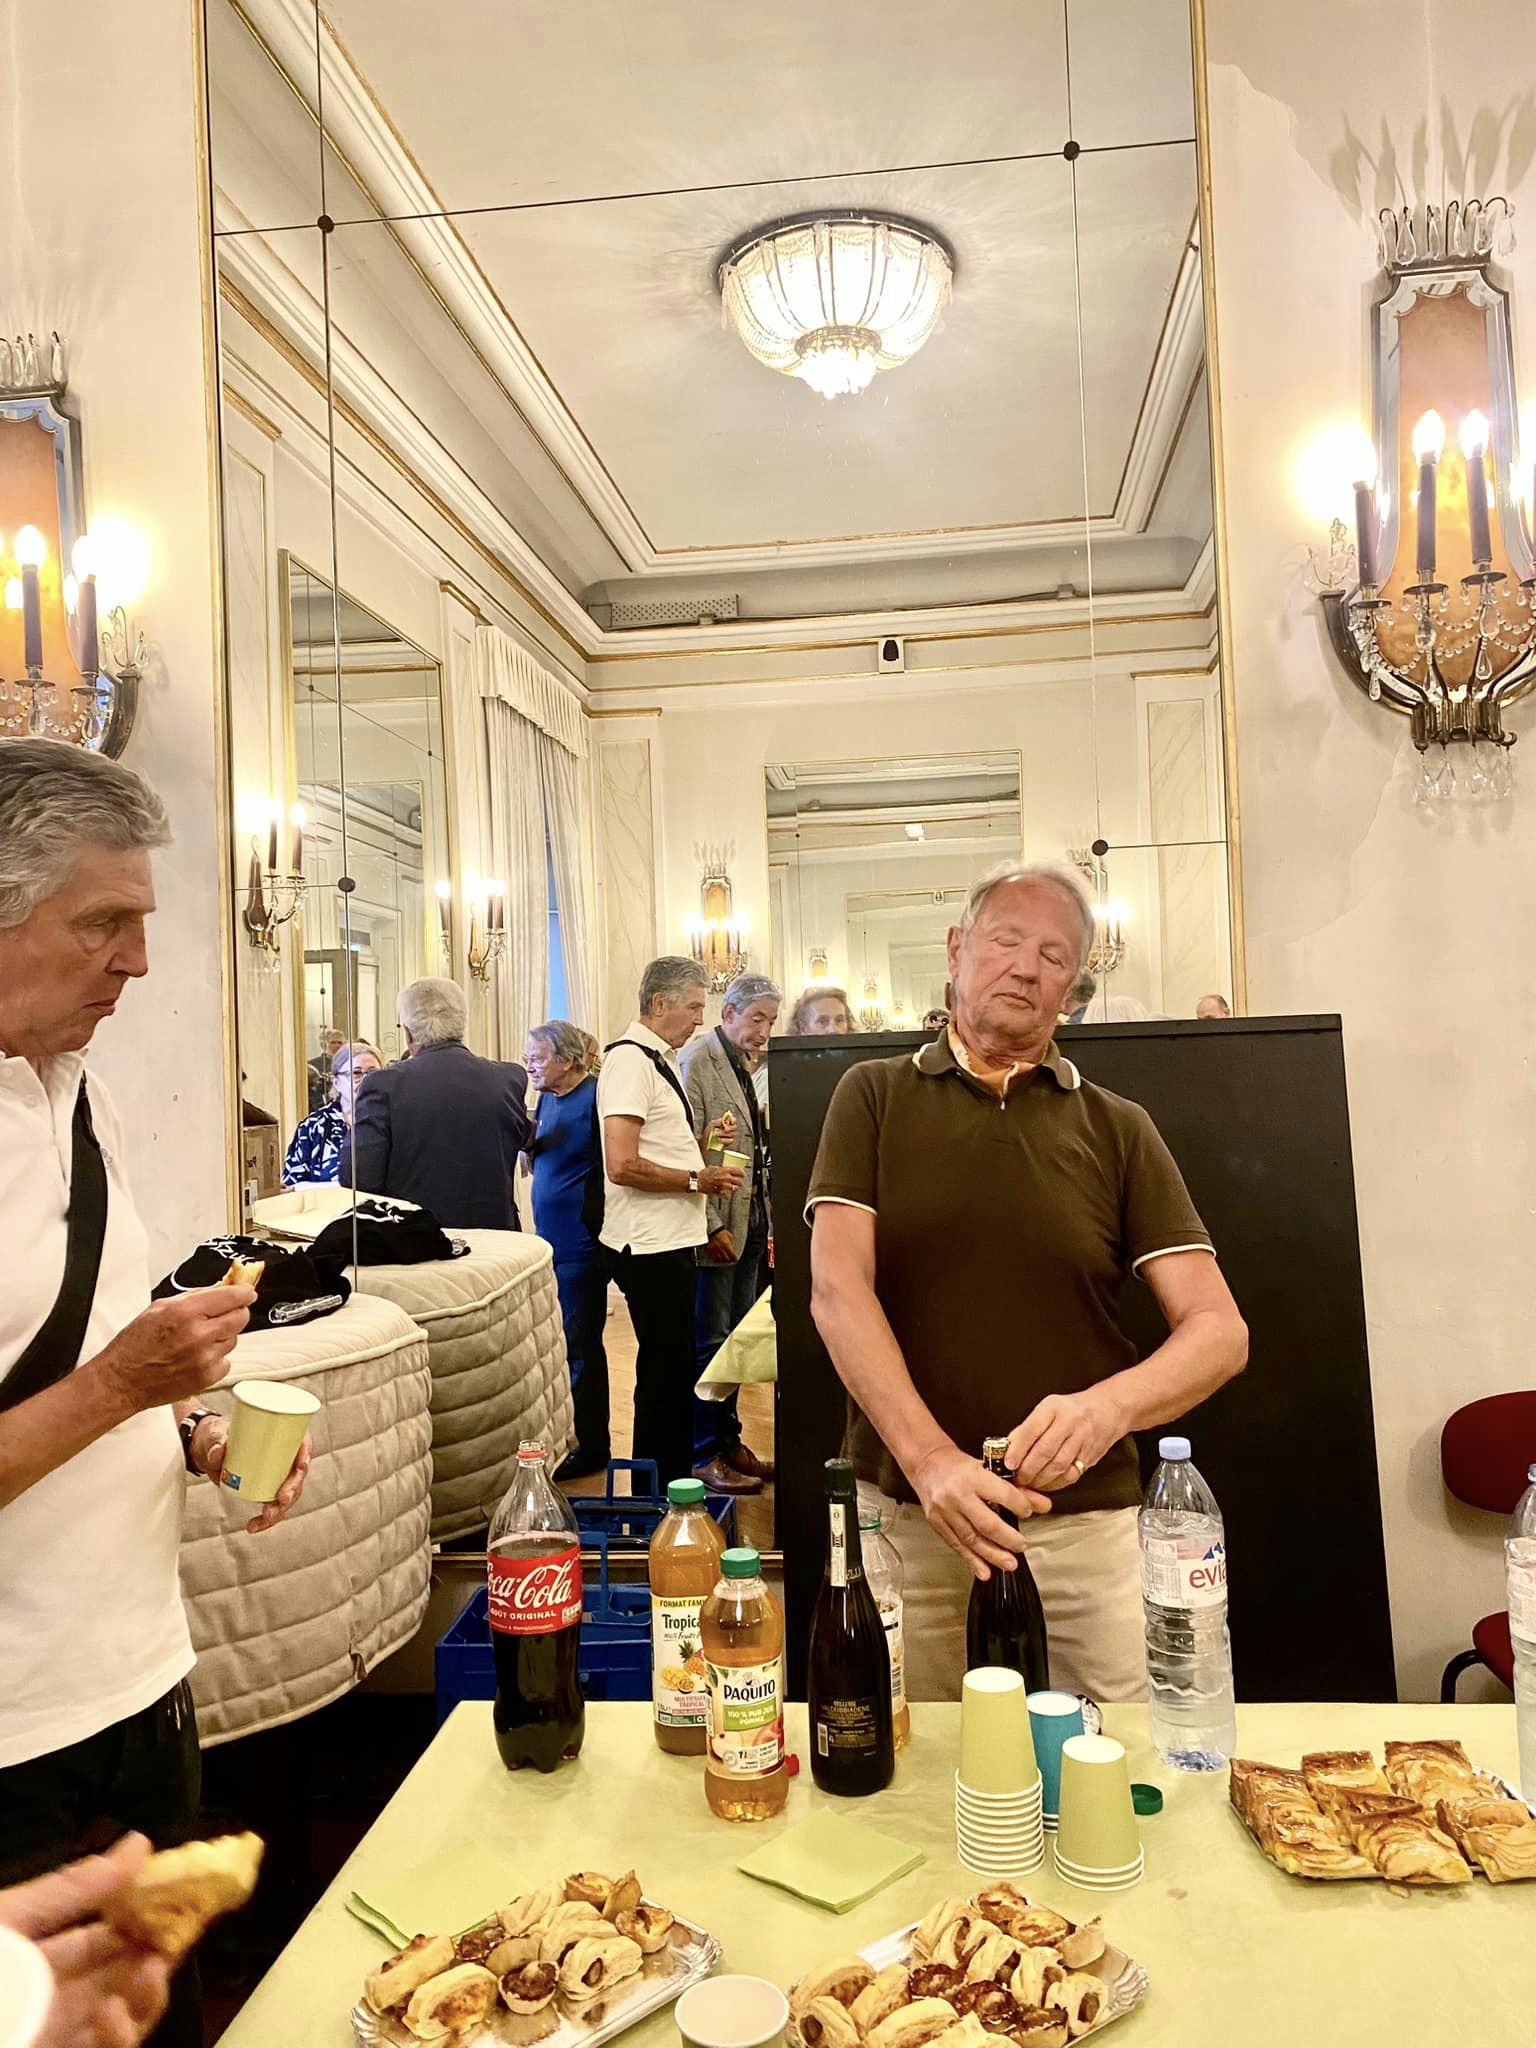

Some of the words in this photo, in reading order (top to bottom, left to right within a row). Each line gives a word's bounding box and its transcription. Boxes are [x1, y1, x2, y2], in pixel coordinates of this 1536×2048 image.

[660, 1600, 686, 1608] FORMAT
[509, 1610, 557, 1621] ORIGINAL
[723, 1679, 776, 1702] PAQUITO
[749, 1709, 762, 1718] PUR
